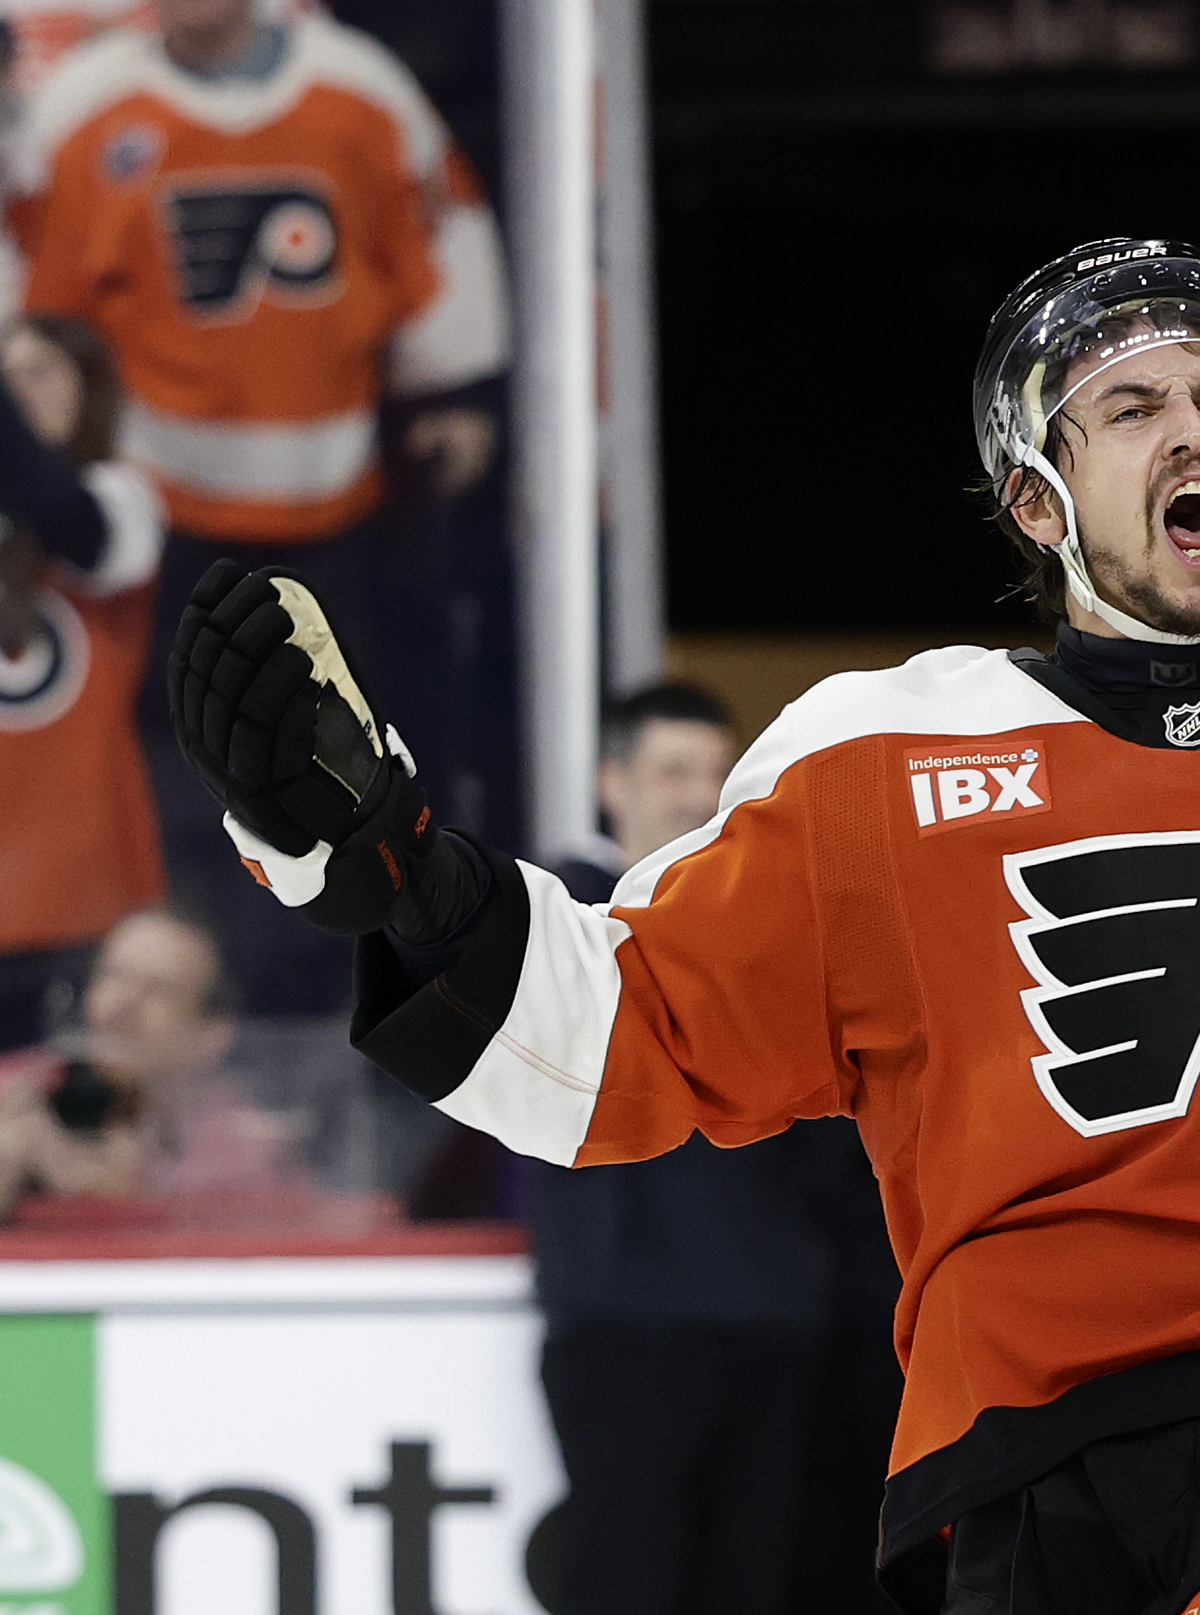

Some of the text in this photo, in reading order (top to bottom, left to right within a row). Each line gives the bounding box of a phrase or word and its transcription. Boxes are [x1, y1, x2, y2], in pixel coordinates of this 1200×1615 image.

[1077, 247, 1167, 271] BAUER
[908, 752, 1018, 770] Independence
[910, 763, 1045, 827] IBX
